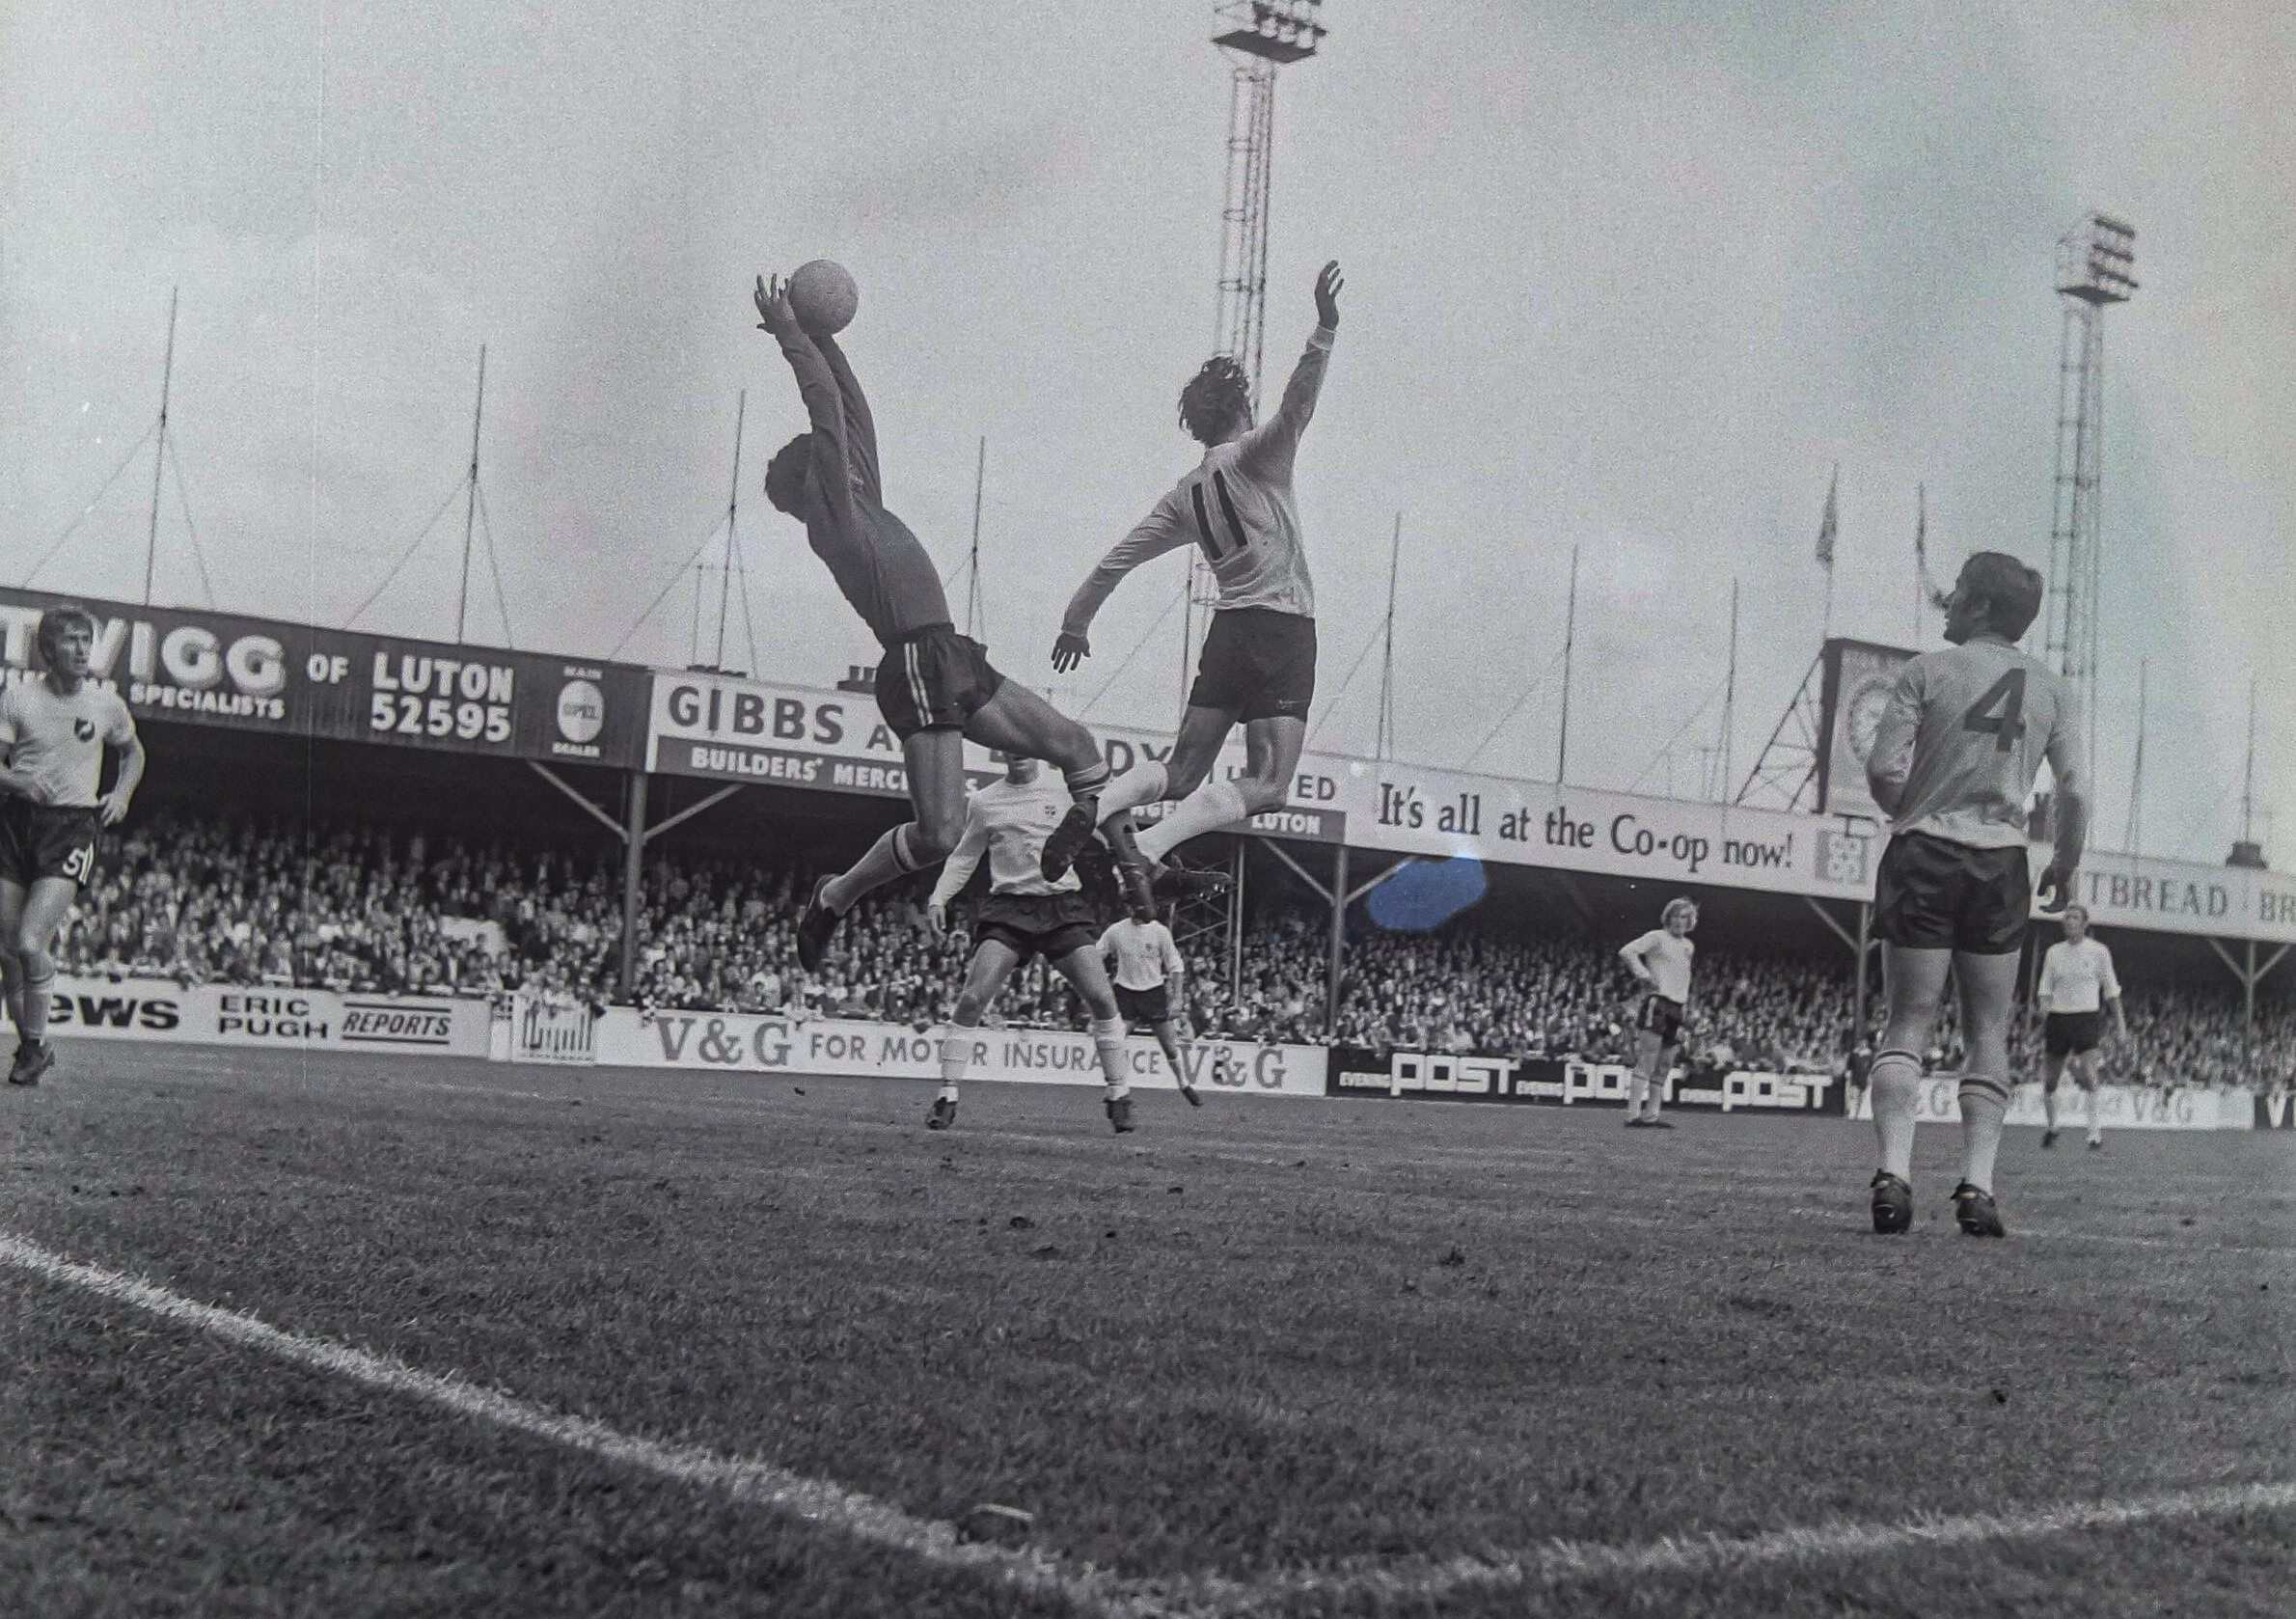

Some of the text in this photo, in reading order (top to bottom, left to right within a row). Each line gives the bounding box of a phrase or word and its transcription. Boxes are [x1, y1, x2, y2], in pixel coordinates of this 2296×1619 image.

[1190, 468, 1248, 561] 11
[308, 653, 349, 684] OF
[373, 651, 514, 703] LUTON
[130, 682, 286, 720] SPECIALISTS
[370, 692, 511, 742] 52595
[668, 685, 844, 745] GIBBS
[1963, 667, 2026, 754] 4
[691, 747, 824, 782] BUILDERS'
[1378, 782, 1424, 828] It's
[1438, 792, 1481, 836] all
[1499, 807, 1531, 842] at
[1545, 805, 1596, 848] the
[1610, 812, 1709, 873] Co-op
[1722, 832, 1792, 868] now!
[45, 994, 180, 1030] ews
[218, 995, 311, 1017] ERIC
[342, 1011, 451, 1036] REPORTS
[218, 1017, 328, 1039] PUGH
[809, 1033, 866, 1062] FOR
[881, 1036, 988, 1068] MOTR
[1003, 1041, 1162, 1075] INSURACE
